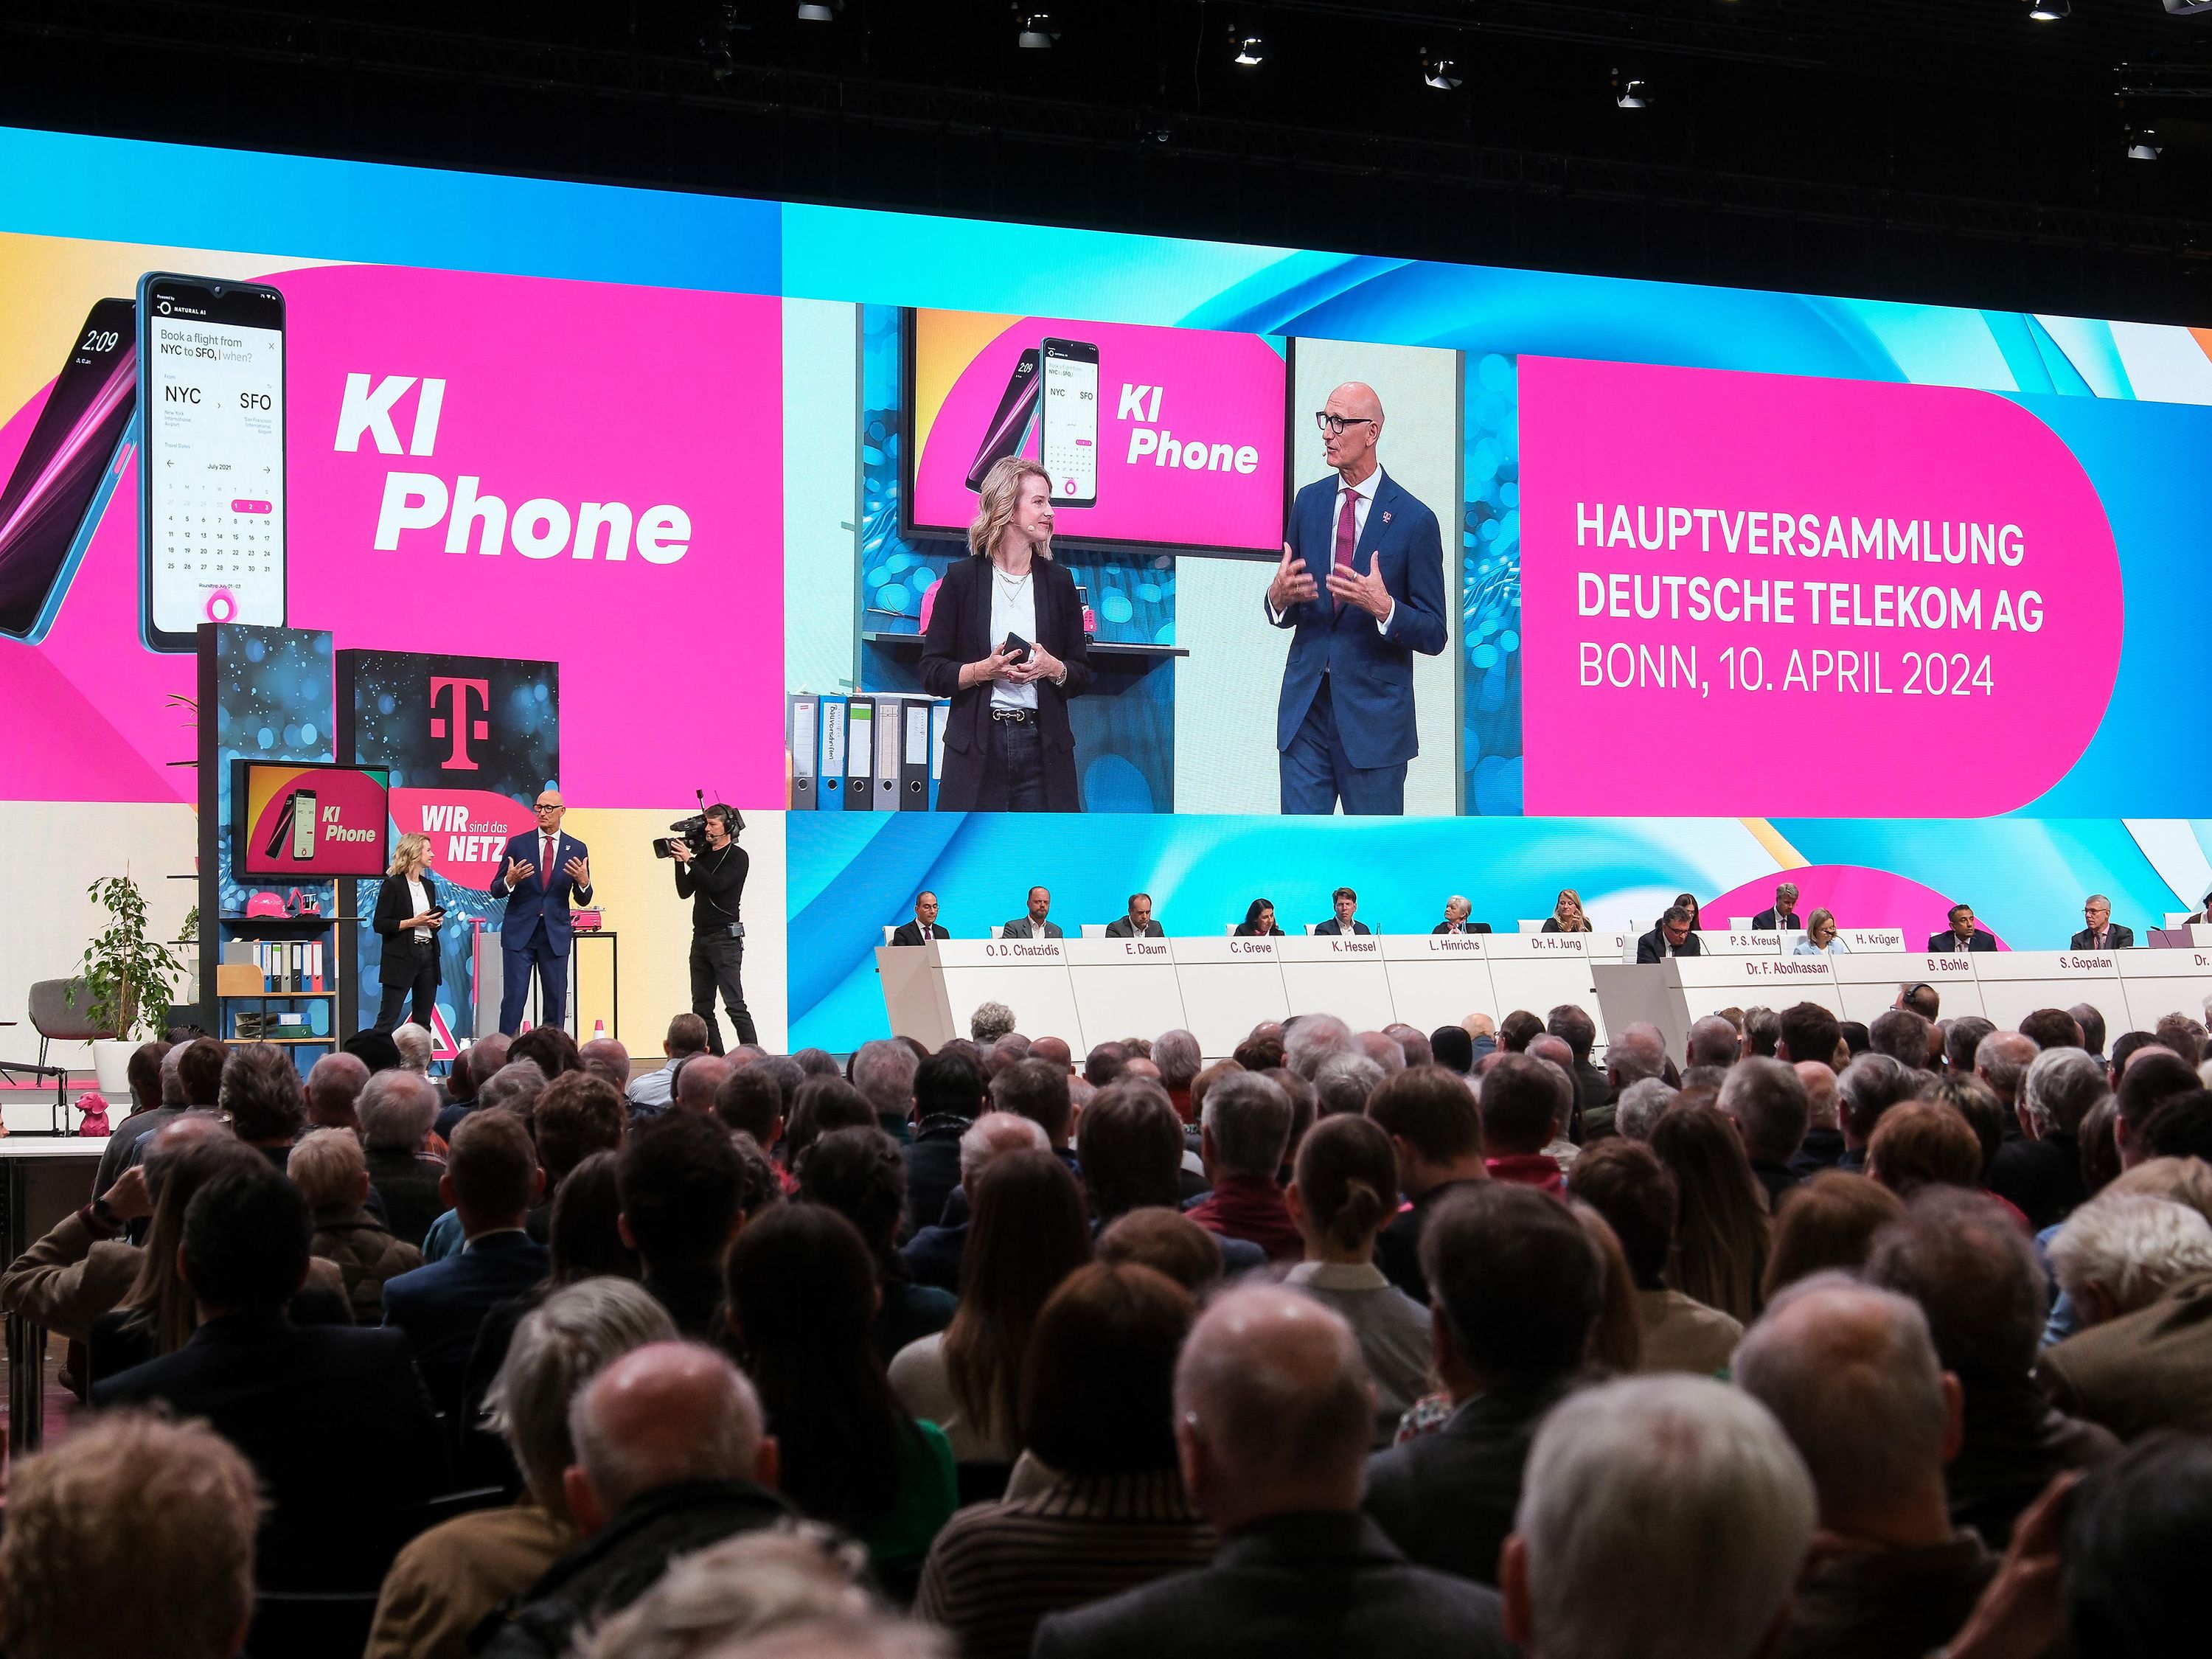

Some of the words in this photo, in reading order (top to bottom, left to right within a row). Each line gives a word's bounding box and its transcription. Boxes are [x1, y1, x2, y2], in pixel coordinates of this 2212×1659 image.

[174, 306, 199, 315] NATURAL
[82, 330, 119, 352] 2:09
[161, 329, 184, 341] Book
[187, 334, 192, 342] a
[195, 333, 218, 347] flight
[220, 335, 243, 347] from
[161, 344, 182, 355] NYC
[184, 347, 194, 357] to
[195, 347, 217, 361] SFO,
[223, 352, 253, 364] when?
[1018, 362, 1033, 373] 2:09
[166, 386, 201, 404] NYC
[1050, 388, 1065, 397] NYC
[1079, 392, 1093, 400] SFO
[240, 392, 271, 411] SFO
[1116, 383, 1164, 423] KI
[333, 372, 446, 457] KI
[1126, 428, 1259, 474] Phone
[373, 471, 692, 565] Phone
[1576, 502, 2025, 566] HAUPTVERSAMMLUNG
[1578, 572, 1795, 624] DEUTSCHE
[1804, 582, 1983, 630] TELEKOM
[1992, 590, 2045, 633] AG
[1579, 642, 1710, 698] BONN,
[1719, 646, 1773, 692] 10.
[1783, 648, 1893, 695] APRIL
[1902, 652, 1994, 696] 2024
[431, 677, 488, 770] T
[322, 806, 341, 823] KI
[422, 805, 469, 832] WIR
[469, 821, 490, 833] sind
[491, 821, 508, 833] das
[325, 824, 376, 843] Phone
[448, 835, 507, 862] NETZ
[1231, 942, 1242, 954] C.
[1243, 942, 1272, 953] Greve
[1332, 940, 1343, 952] K.
[1345, 940, 1377, 953] Hessel
[1430, 939, 1439, 951] L.
[1441, 938, 1480, 951] Hinrichs
[1531, 938, 1546, 950] Dr.
[1548, 938, 1558, 949] H.
[1560, 937, 1582, 951] Jung
[1731, 936, 1739, 946] P.
[1741, 936, 1750, 946] S.
[1856, 933, 1866, 945] H.
[1868, 933, 1899, 947] Krüger
[986, 945, 998, 956] O.
[1001, 945, 1012, 956] D.
[1013, 944, 1060, 956] Chatzidis
[1125, 944, 1136, 955] E.
[1138, 943, 1167, 955] Daum
[1746, 962, 1761, 975] Dr.
[1763, 962, 1772, 975] F.
[1773, 961, 1829, 975] Abolhassan
[1927, 959, 1939, 971] B.
[1941, 958, 1969, 971] Bohle
[2059, 957, 2070, 970] S.
[2072, 956, 2112, 971] Gopalan
[2194, 954, 2210, 966] Dr.
